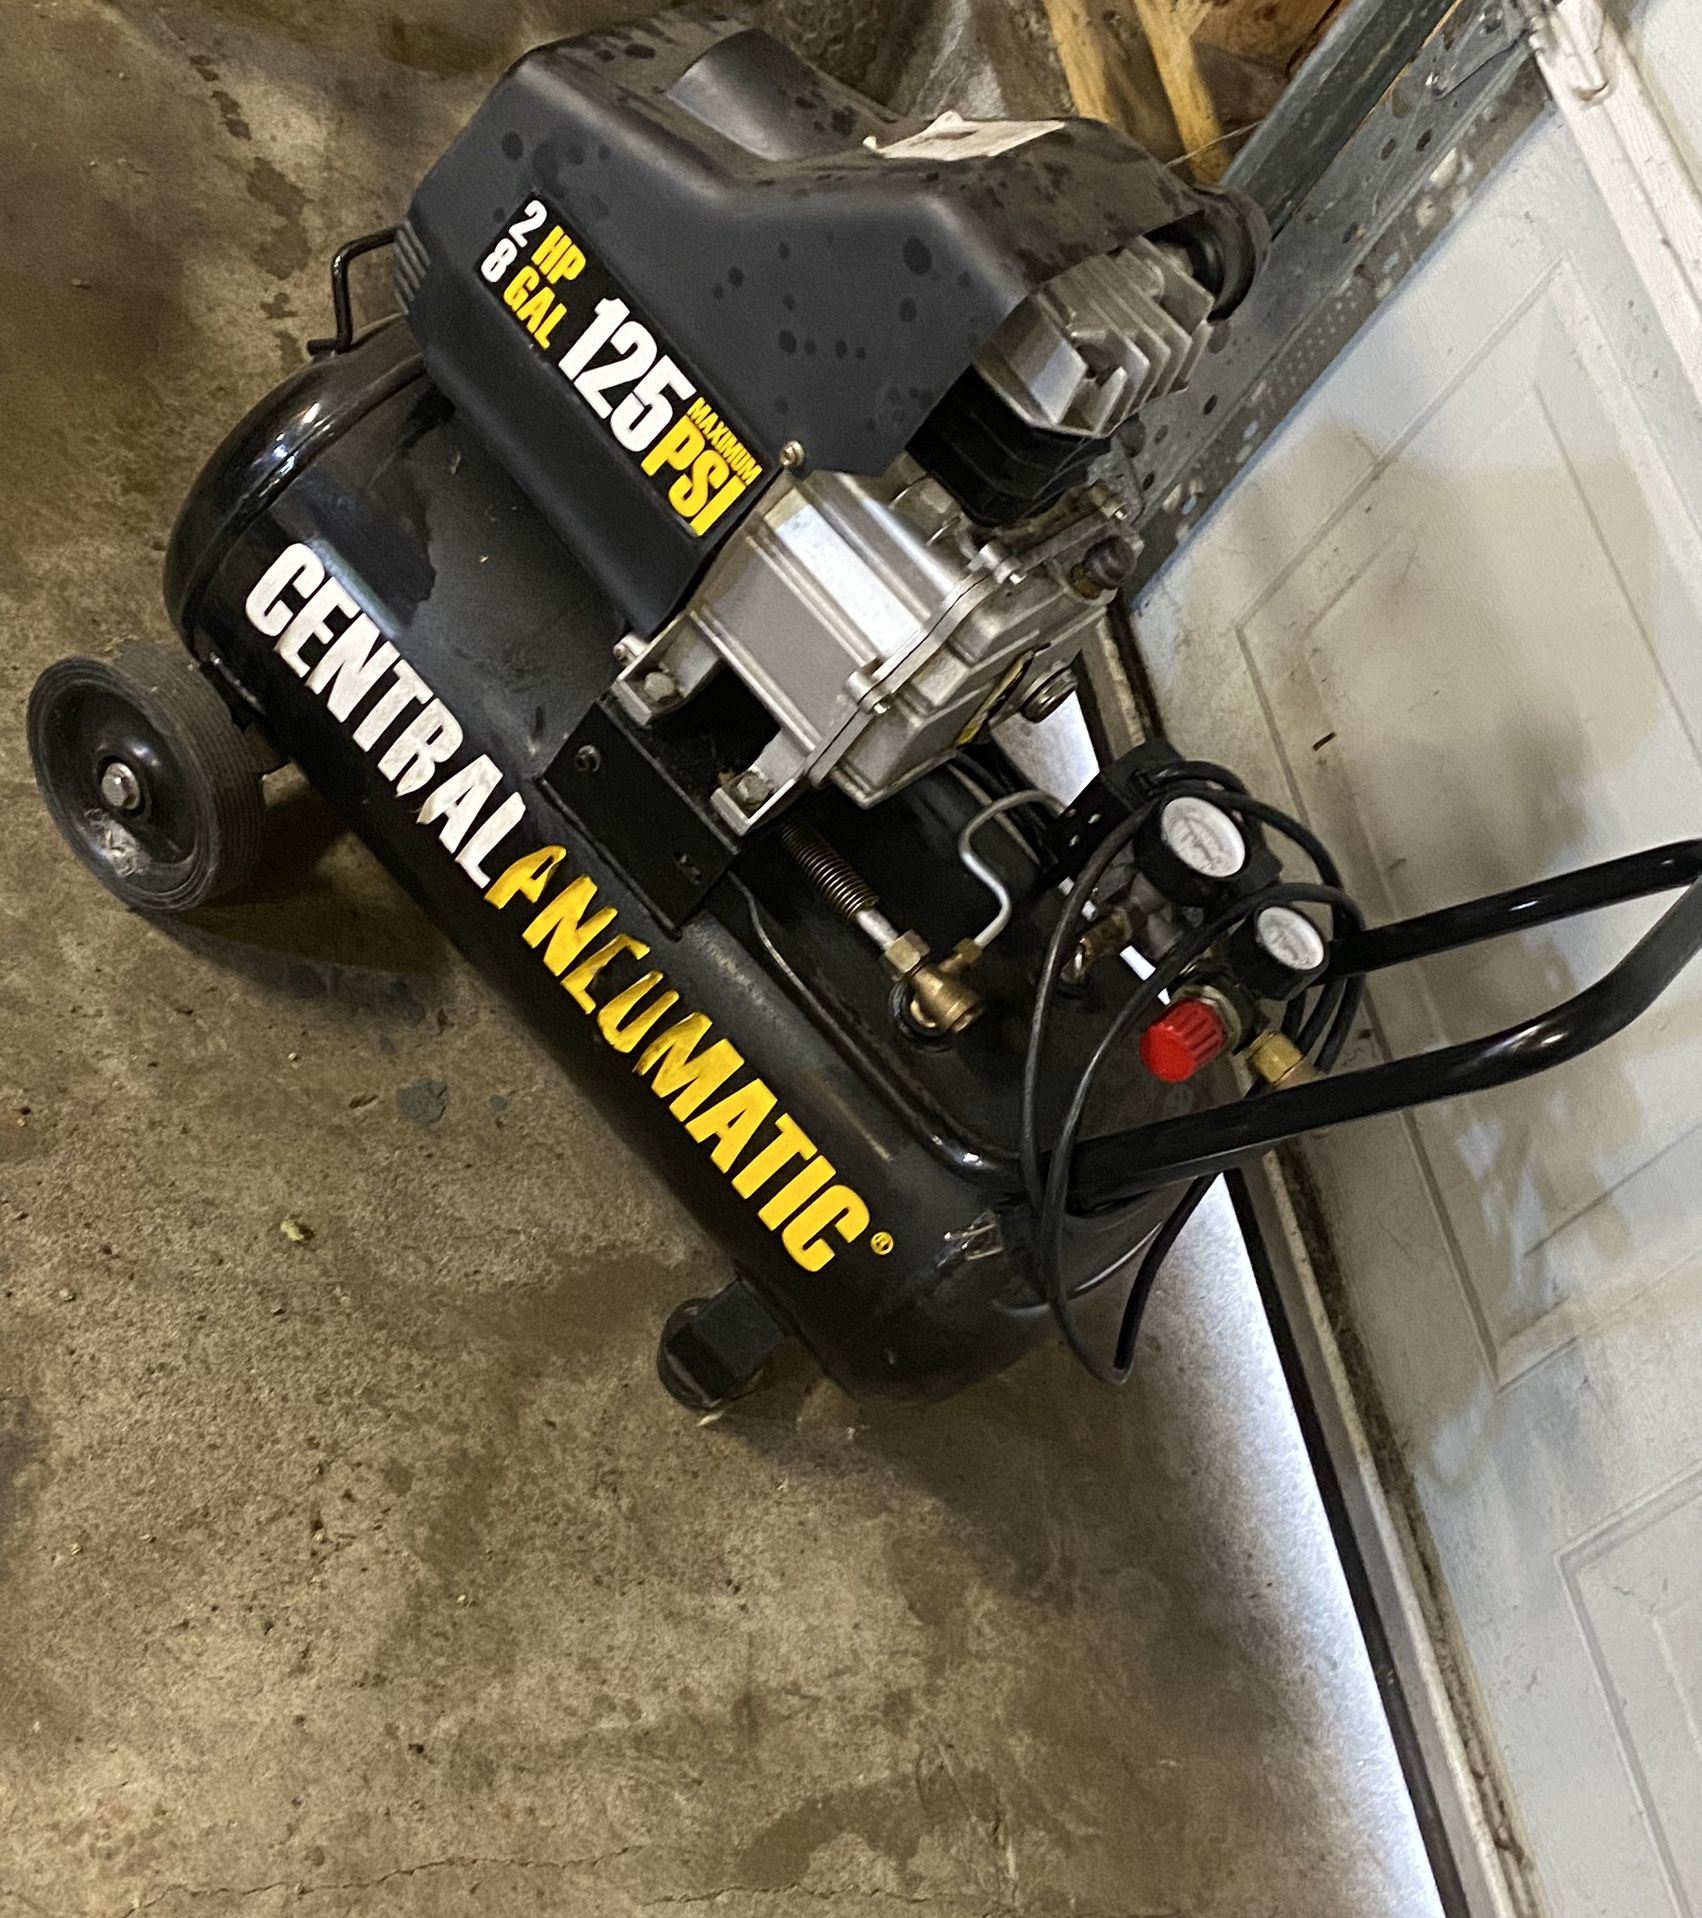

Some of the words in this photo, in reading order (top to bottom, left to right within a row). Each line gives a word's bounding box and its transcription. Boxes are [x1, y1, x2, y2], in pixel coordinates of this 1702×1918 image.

[481, 238, 518, 283] 8
[503, 265, 567, 349] GAL
[508, 199, 548, 247] 2
[531, 225, 587, 284] HP
[558, 297, 697, 452] 125
[640, 414, 746, 537] PSI
[686, 397, 763, 486] MAXIMUM
[245, 542, 527, 889] CENTRAL
